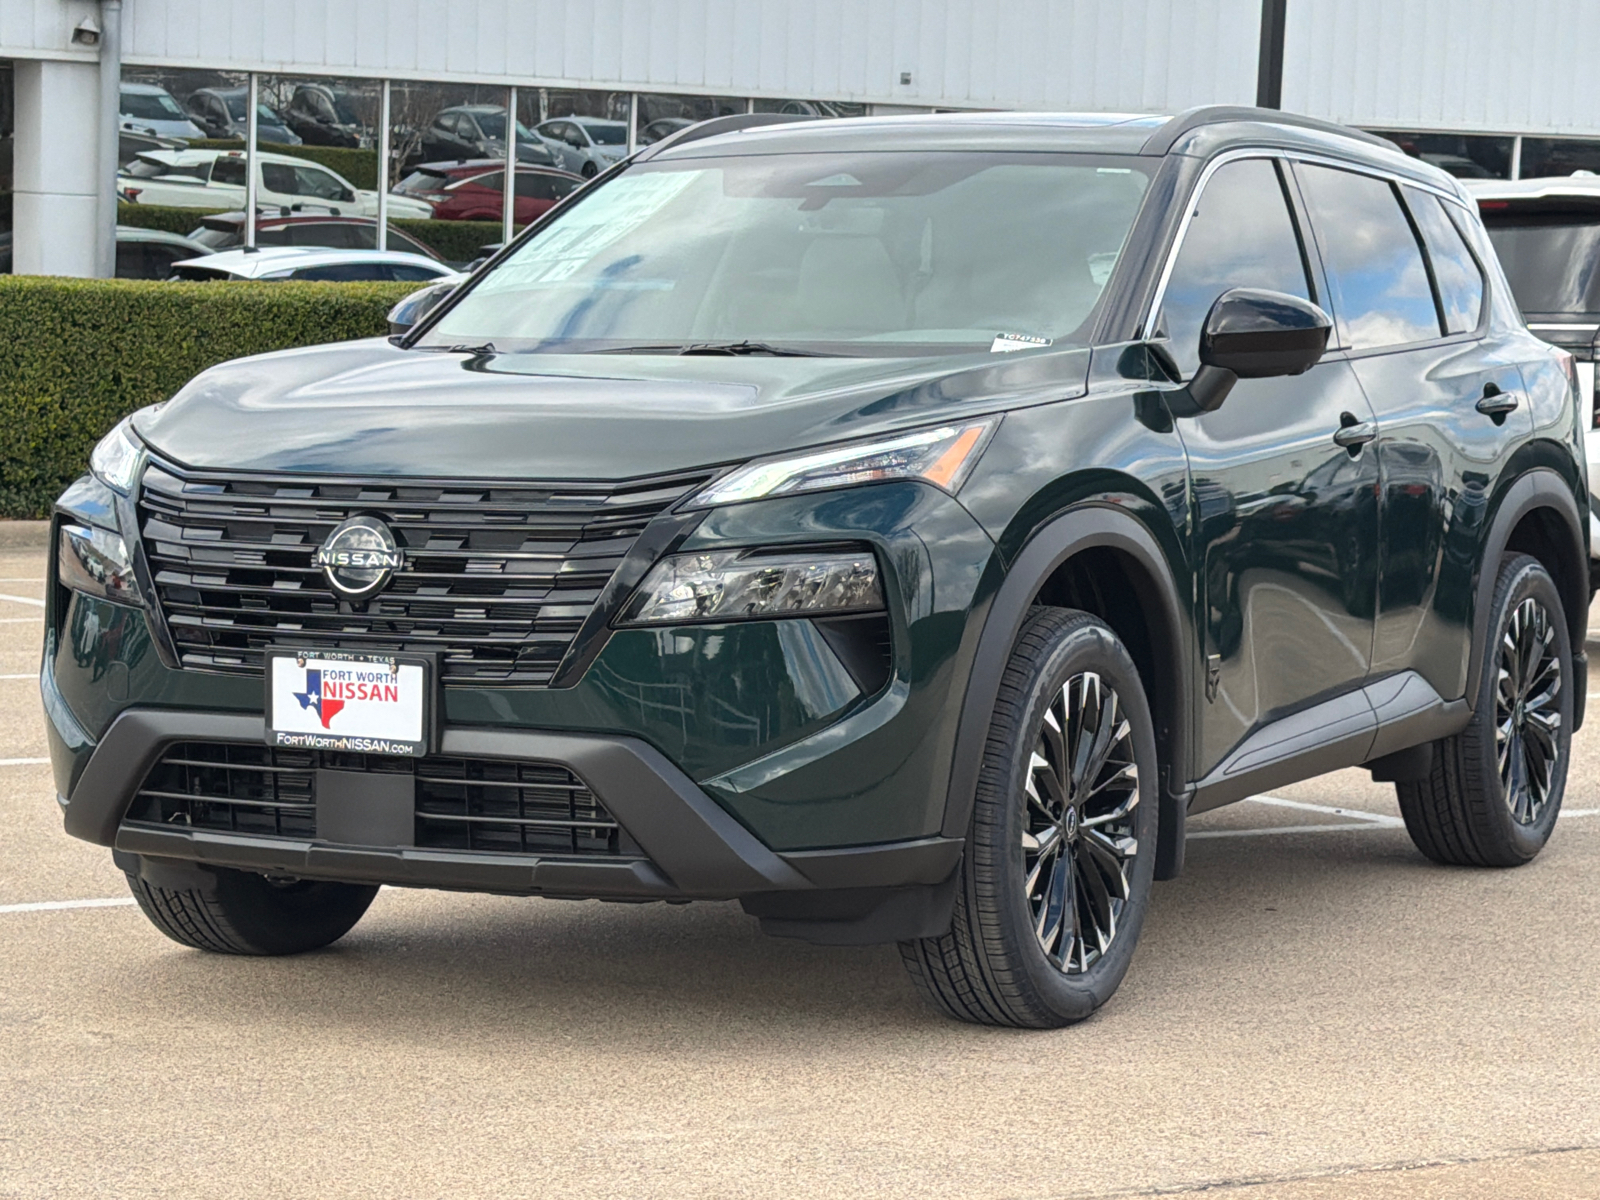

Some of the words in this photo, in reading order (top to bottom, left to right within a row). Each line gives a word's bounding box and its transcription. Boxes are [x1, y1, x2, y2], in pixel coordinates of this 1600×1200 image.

[318, 551, 398, 566] NISSAN
[297, 651, 320, 659] FORT
[323, 652, 354, 661] WORTH
[367, 655, 395, 664] TEXAS
[323, 669, 353, 681] FORT
[356, 671, 398, 684] WORTH
[323, 681, 398, 702] NISSAN
